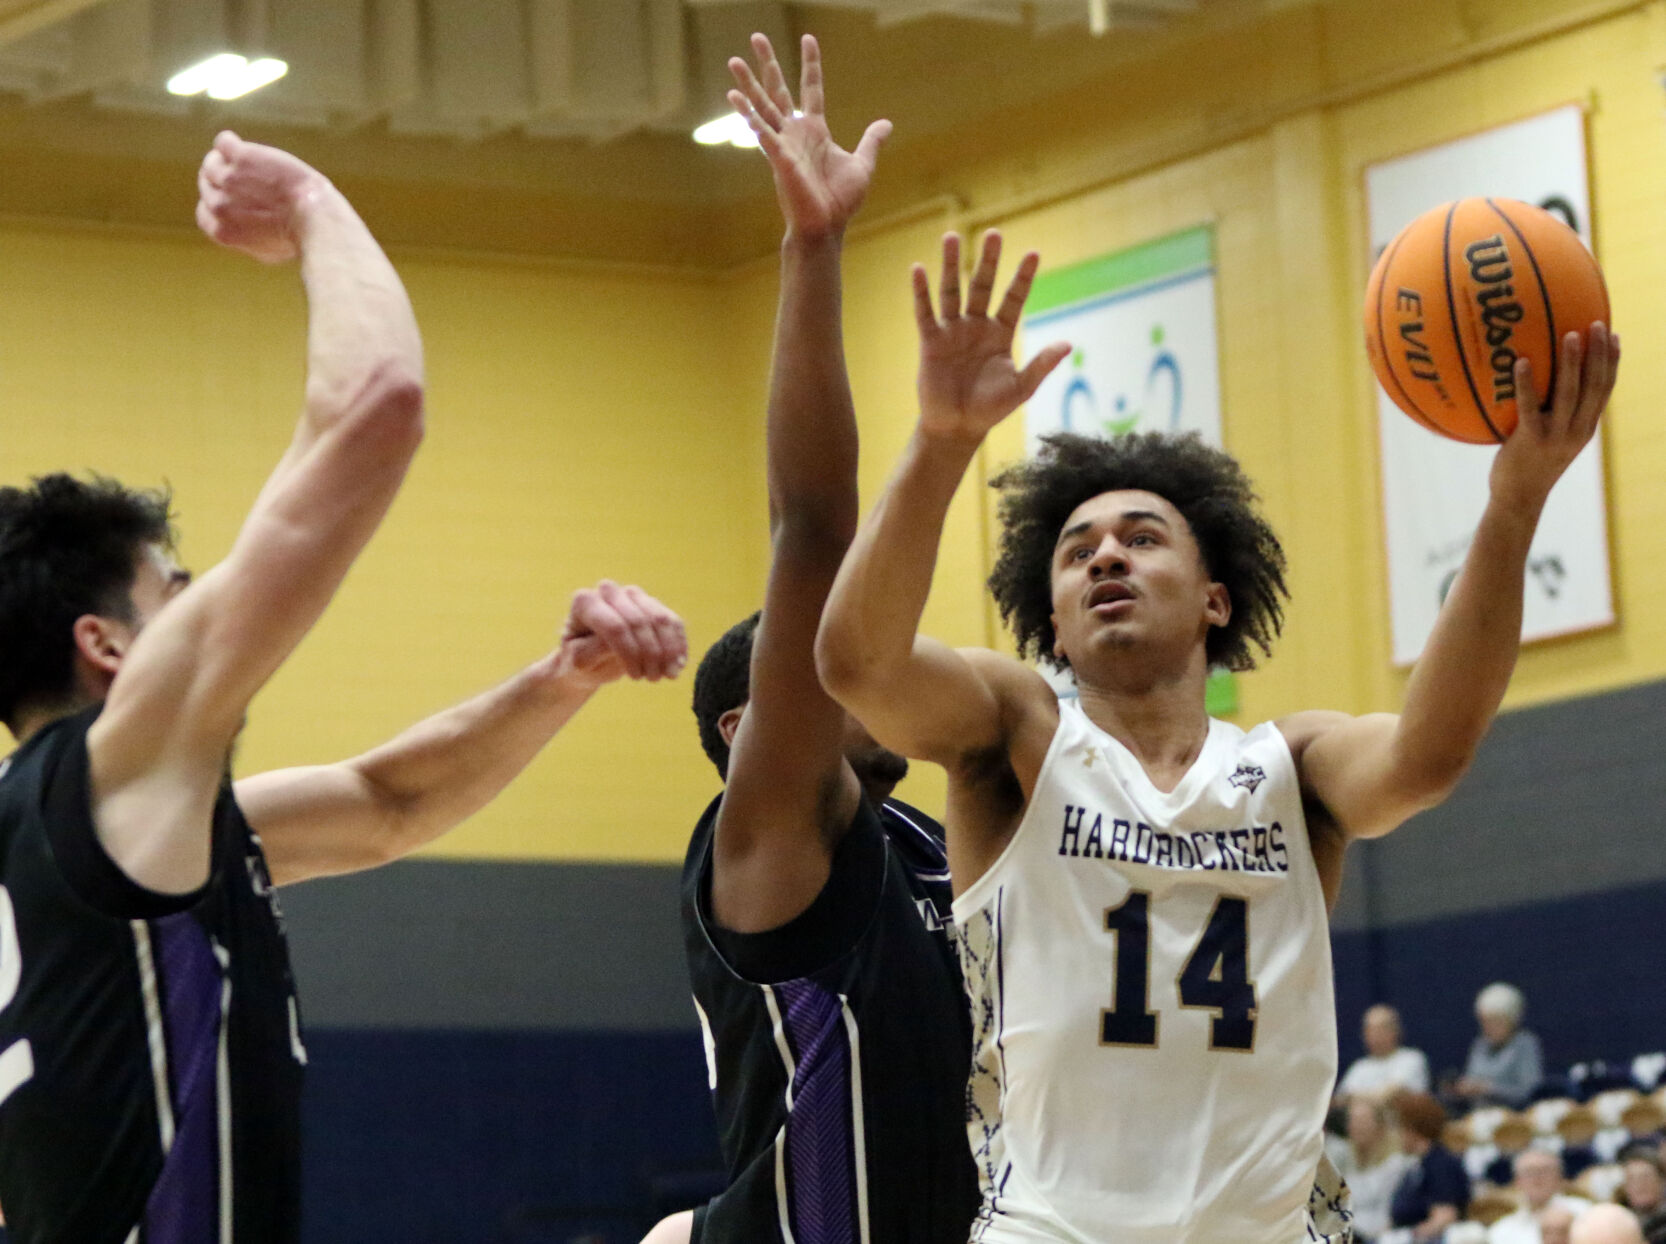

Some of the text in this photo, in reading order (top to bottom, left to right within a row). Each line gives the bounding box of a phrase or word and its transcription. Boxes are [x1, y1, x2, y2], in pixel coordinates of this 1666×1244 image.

[1465, 234, 1524, 402] Wilson
[1058, 804, 1289, 872] HARDROCKERS
[1098, 887, 1259, 1054] 14
